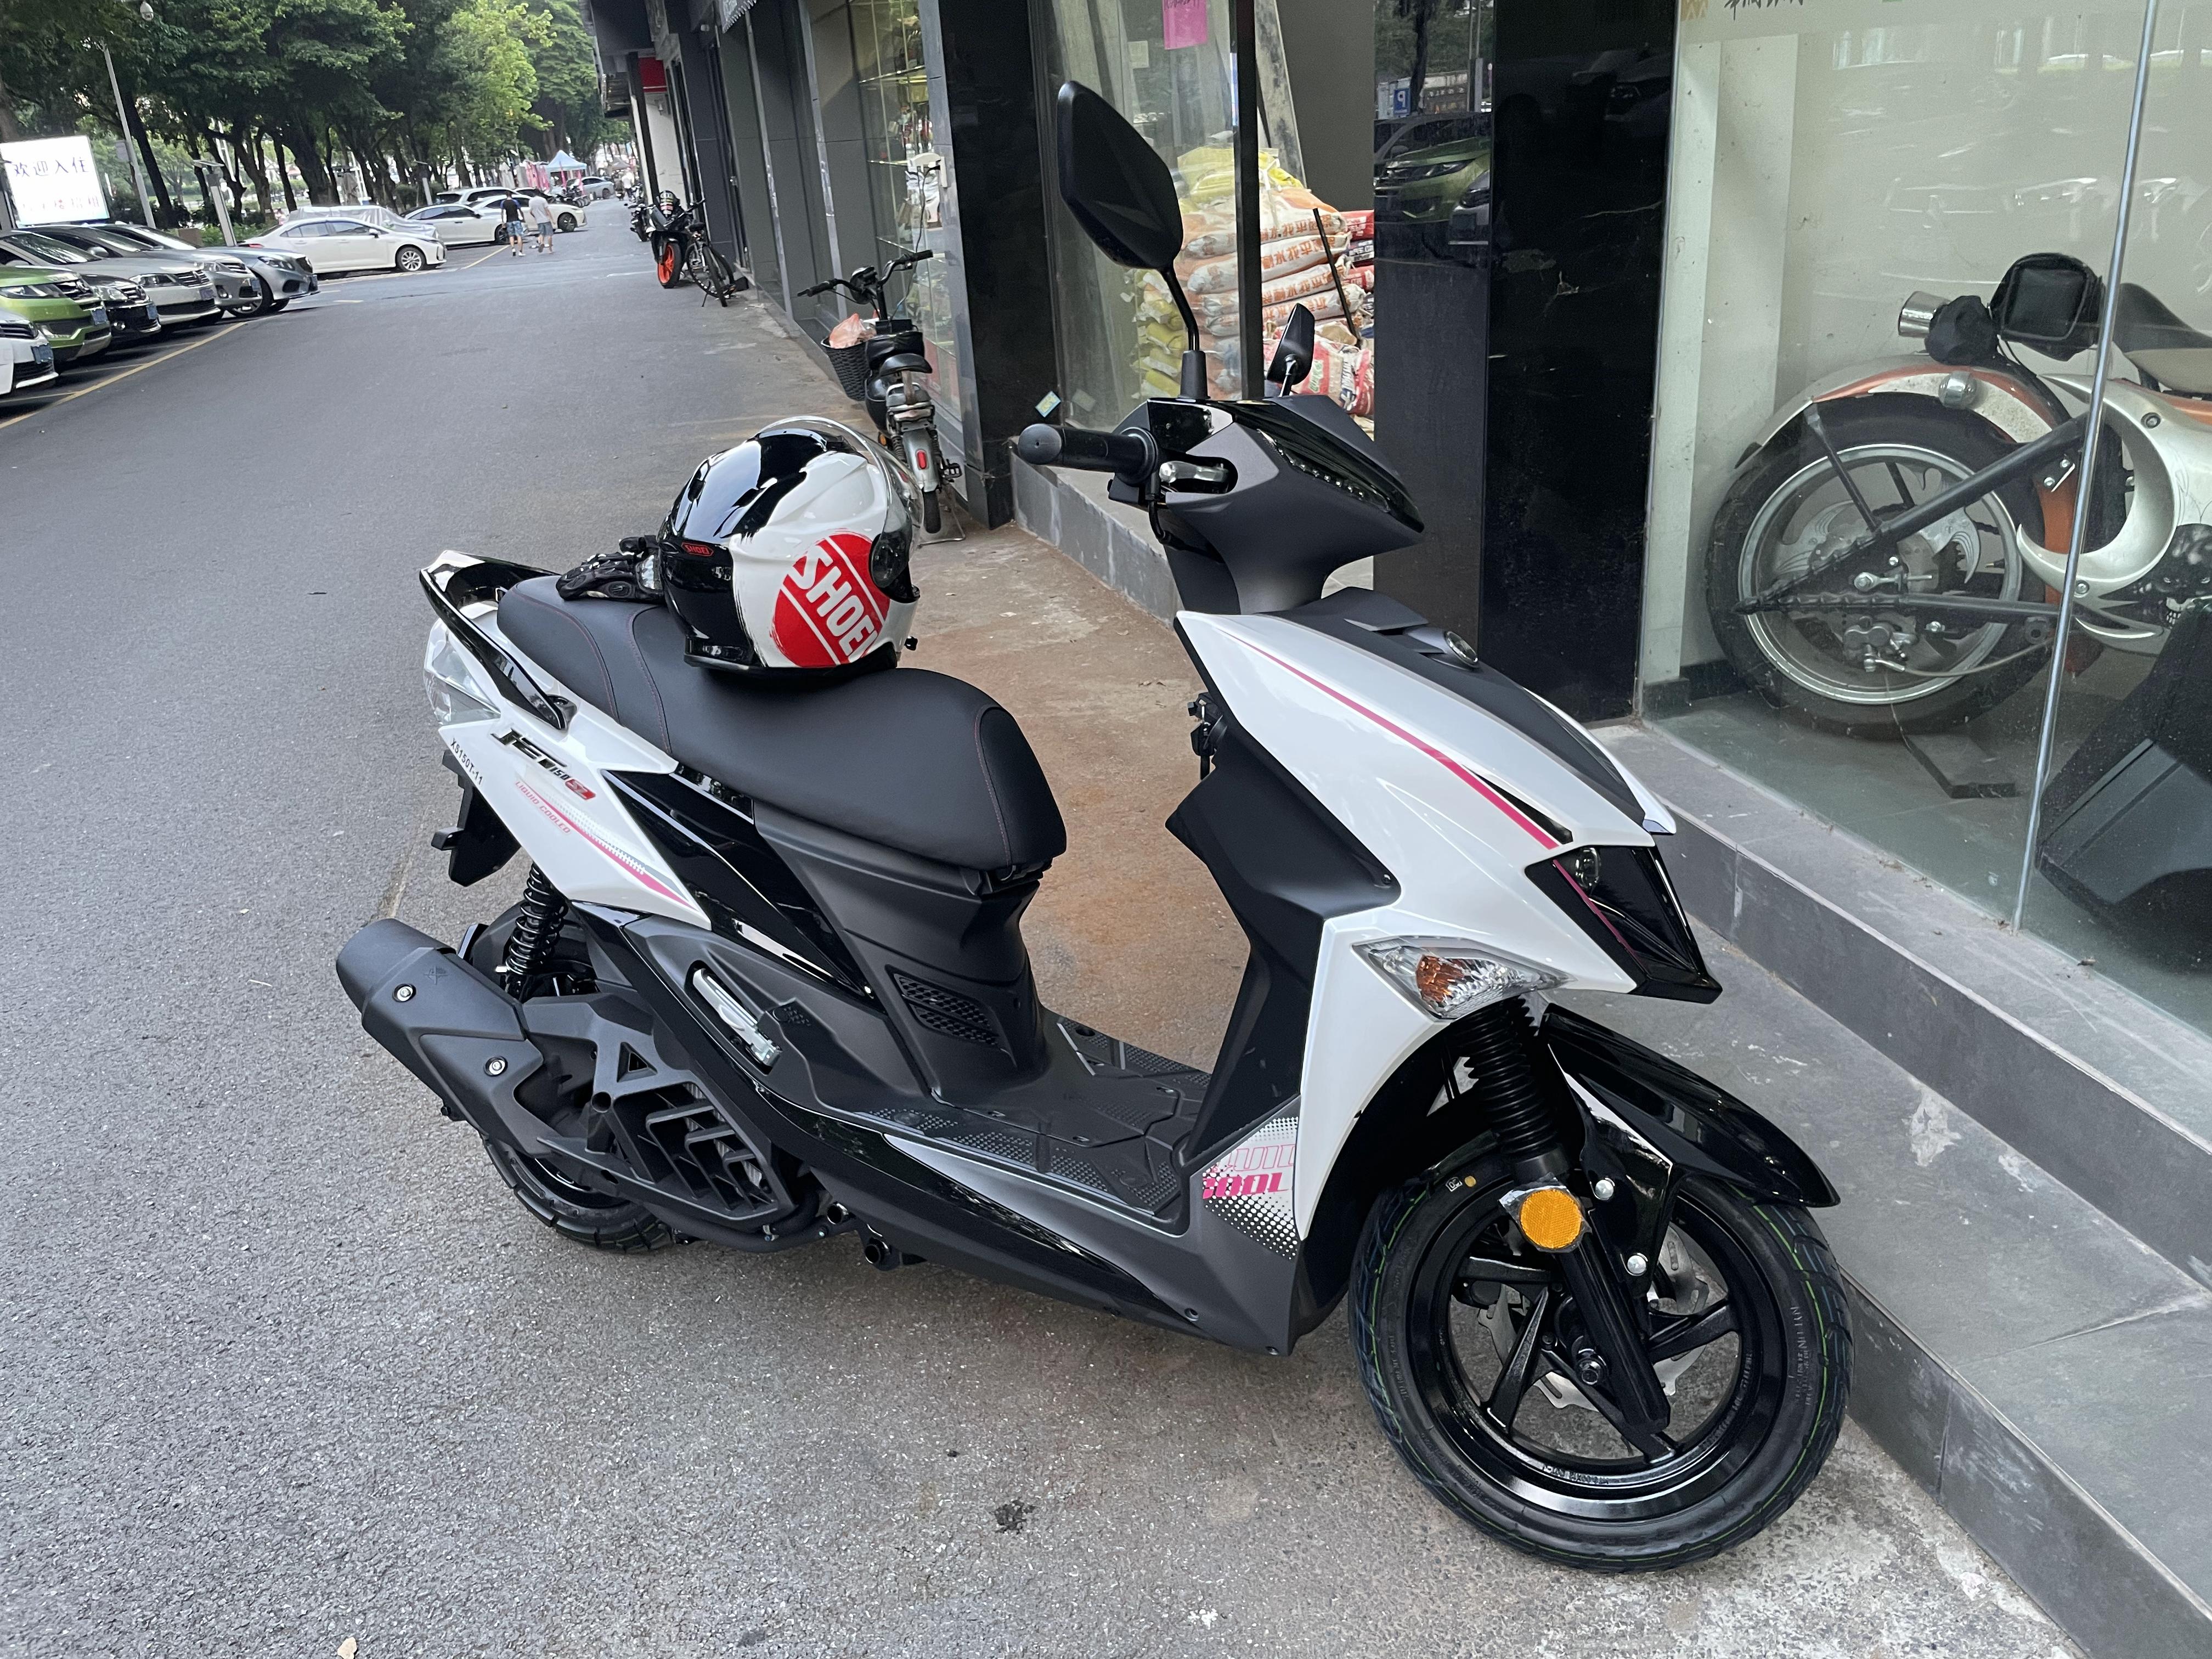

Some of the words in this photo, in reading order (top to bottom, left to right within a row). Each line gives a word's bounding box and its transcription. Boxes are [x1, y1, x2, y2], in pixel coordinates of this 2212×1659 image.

[13, 157, 90, 177] 欢迎入住
[450, 737, 483, 786] XS150T-11
[549, 767, 572, 781] 150
[515, 781, 540, 805] LIQUID
[539, 805, 571, 834] COOLED
